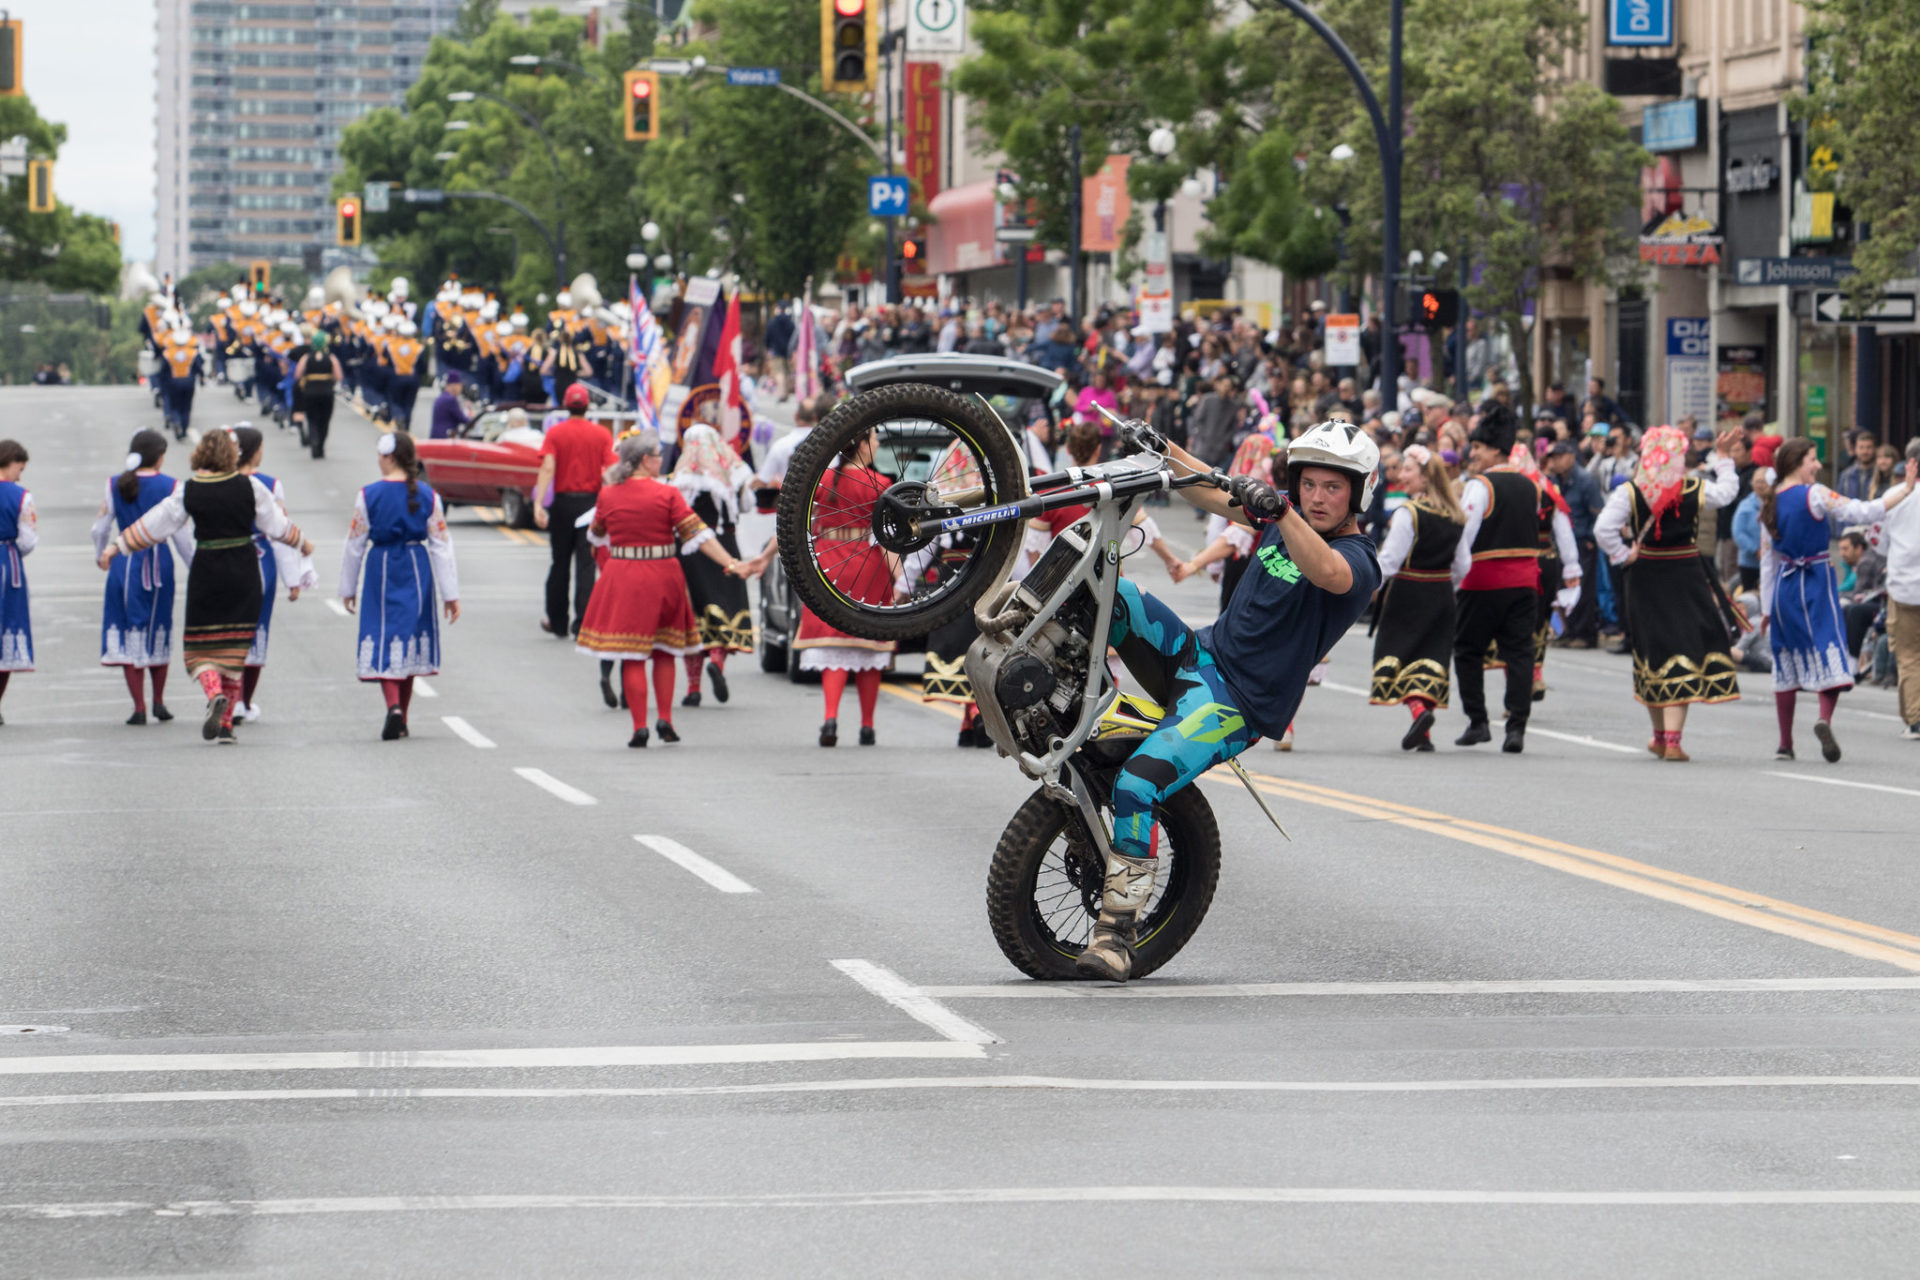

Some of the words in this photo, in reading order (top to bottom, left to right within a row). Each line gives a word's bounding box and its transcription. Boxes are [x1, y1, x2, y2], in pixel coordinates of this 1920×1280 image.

[871, 182, 891, 210] P
[1640, 245, 1720, 265] PIZZA
[1766, 260, 1832, 282] Johnson
[962, 508, 1016, 526] MICHELIN
